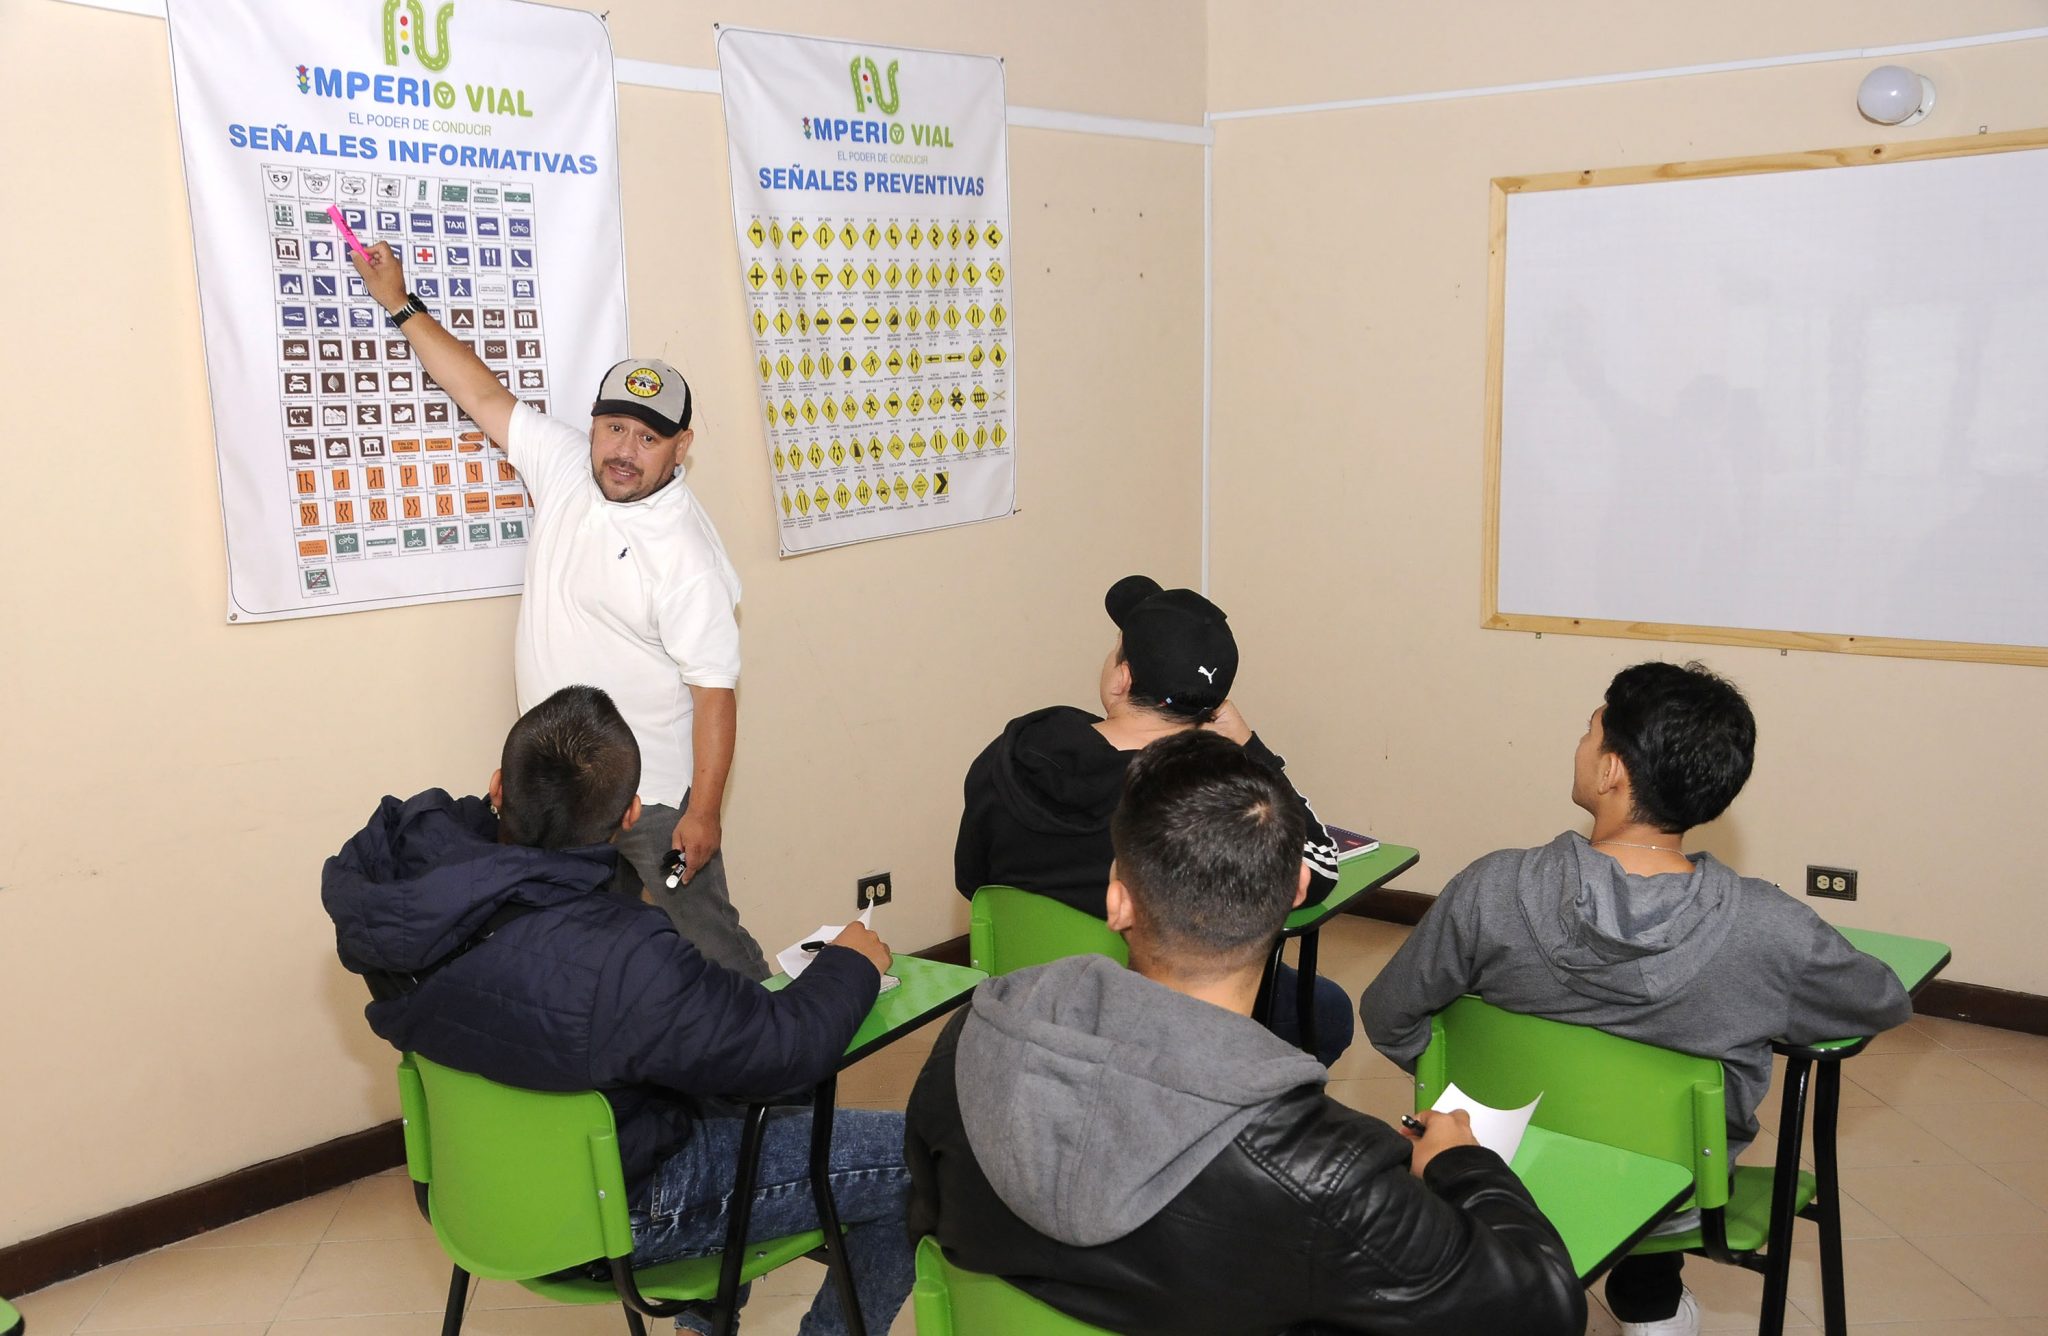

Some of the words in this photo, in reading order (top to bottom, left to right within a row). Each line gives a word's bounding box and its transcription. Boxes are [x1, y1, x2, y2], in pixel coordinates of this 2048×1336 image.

[465, 84, 533, 117] VIAL
[348, 112, 365, 125] EL
[367, 113, 410, 130] PODER
[413, 117, 430, 131] DE
[432, 119, 492, 136] CONDUCIR
[911, 124, 954, 148] VIAL
[229, 123, 378, 159] SEÑALES
[389, 139, 598, 175] INFORMATIVAS
[837, 150, 847, 161] EL
[849, 151, 876, 162] PODER
[877, 153, 888, 163] DE
[889, 153, 928, 165] CONDUCIR
[273, 174, 288, 183] 59
[759, 164, 858, 191] SEÑALES
[864, 174, 984, 197] PREVENTIVAS
[345, 211, 361, 228] P
[380, 212, 396, 229] P
[446, 220, 465, 230] TAXI
